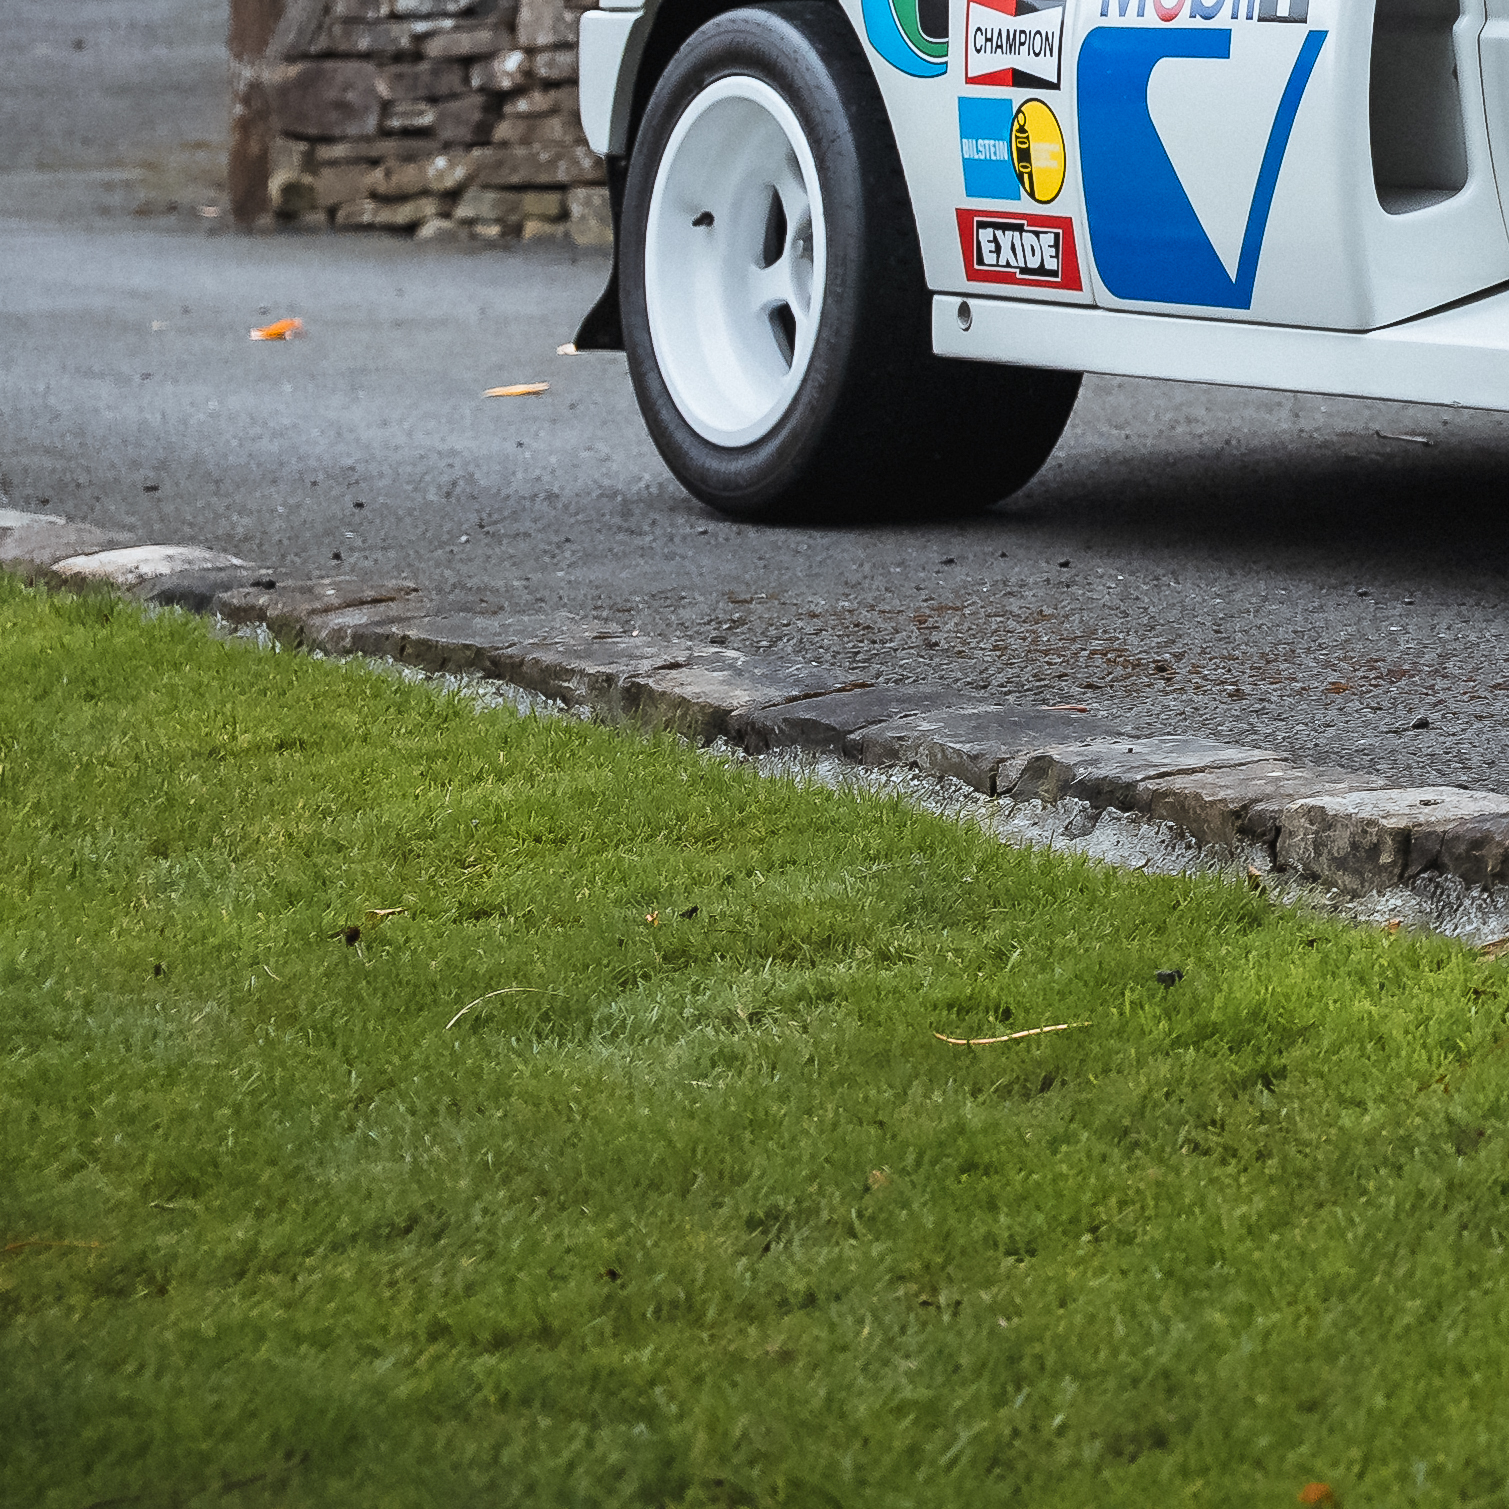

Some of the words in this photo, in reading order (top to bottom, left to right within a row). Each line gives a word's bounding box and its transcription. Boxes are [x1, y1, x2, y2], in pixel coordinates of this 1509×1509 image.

[972, 24, 1055, 59] CHAMPION
[962, 138, 1009, 161] BILSTEIN
[978, 227, 1059, 271] EXIDE
